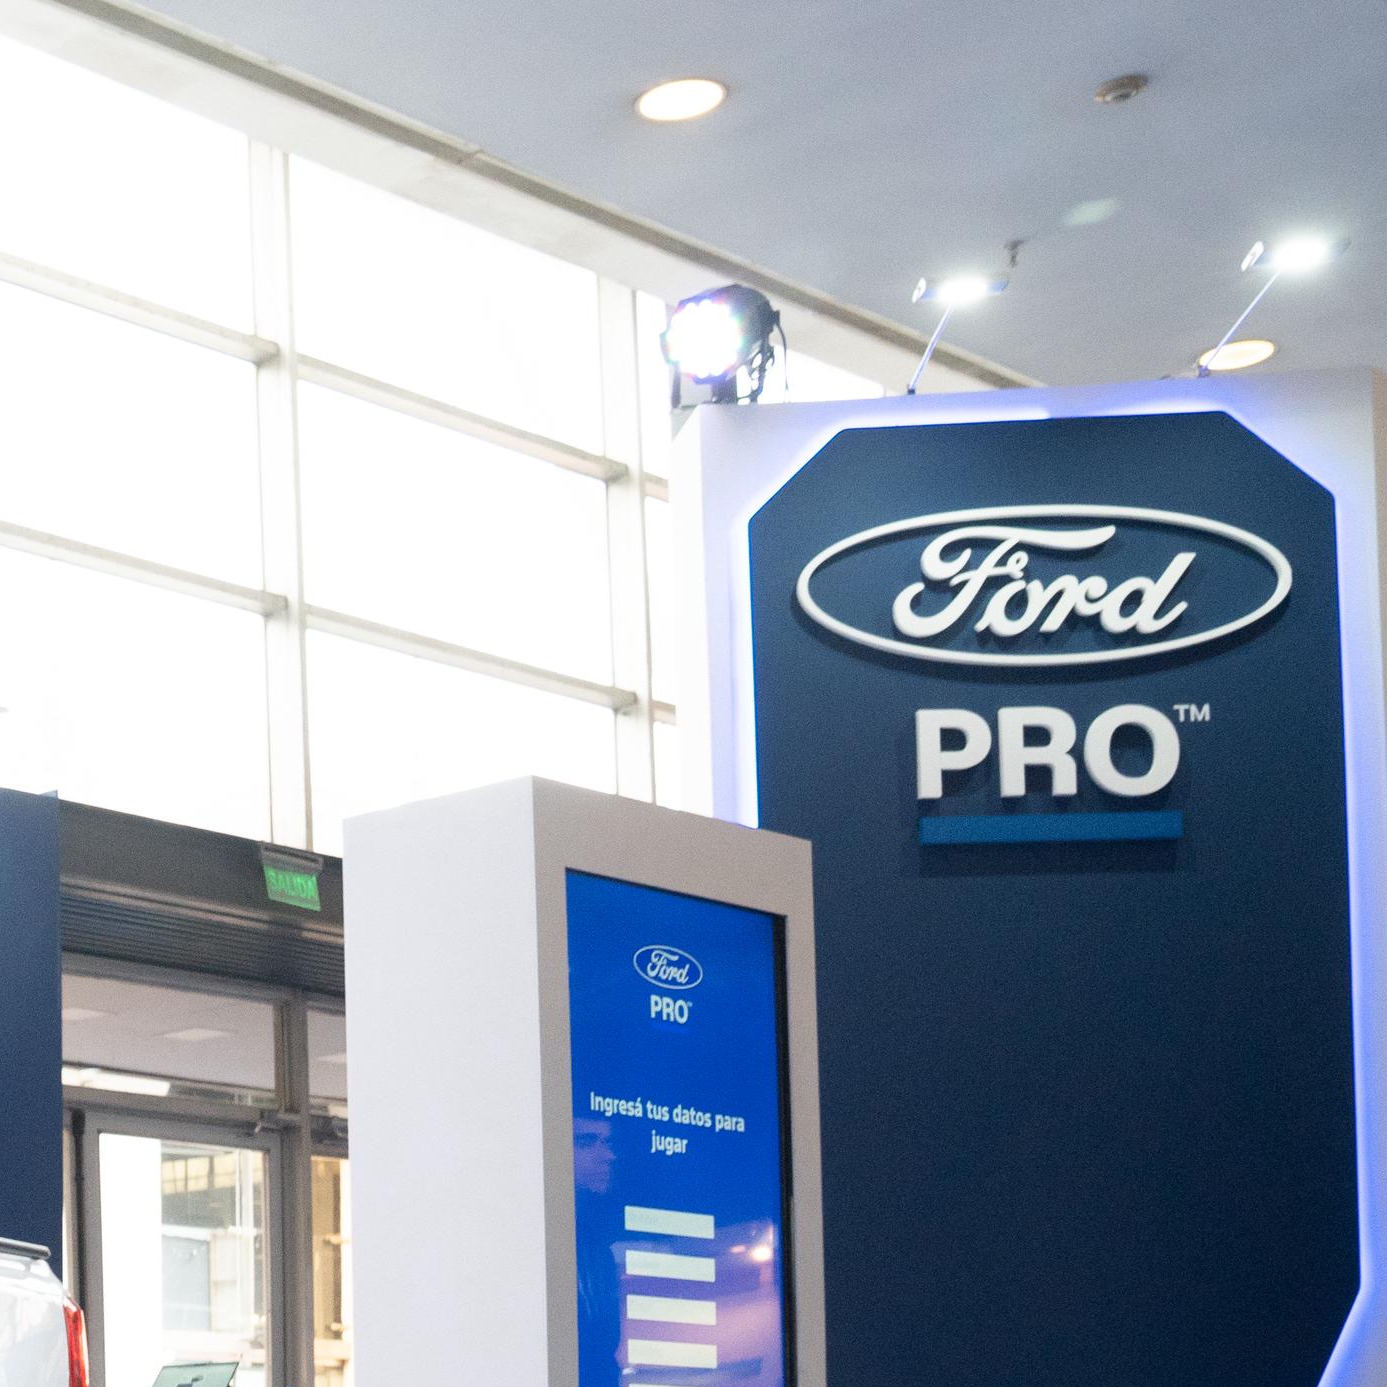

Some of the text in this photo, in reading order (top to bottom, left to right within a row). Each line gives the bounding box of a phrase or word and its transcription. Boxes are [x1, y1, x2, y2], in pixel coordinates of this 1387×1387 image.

[891, 524, 1196, 638] Ford
[646, 949, 691, 984] Ford
[589, 1091, 745, 1133] Ingresá tus datos para
[651, 1130, 688, 1155] jugar
